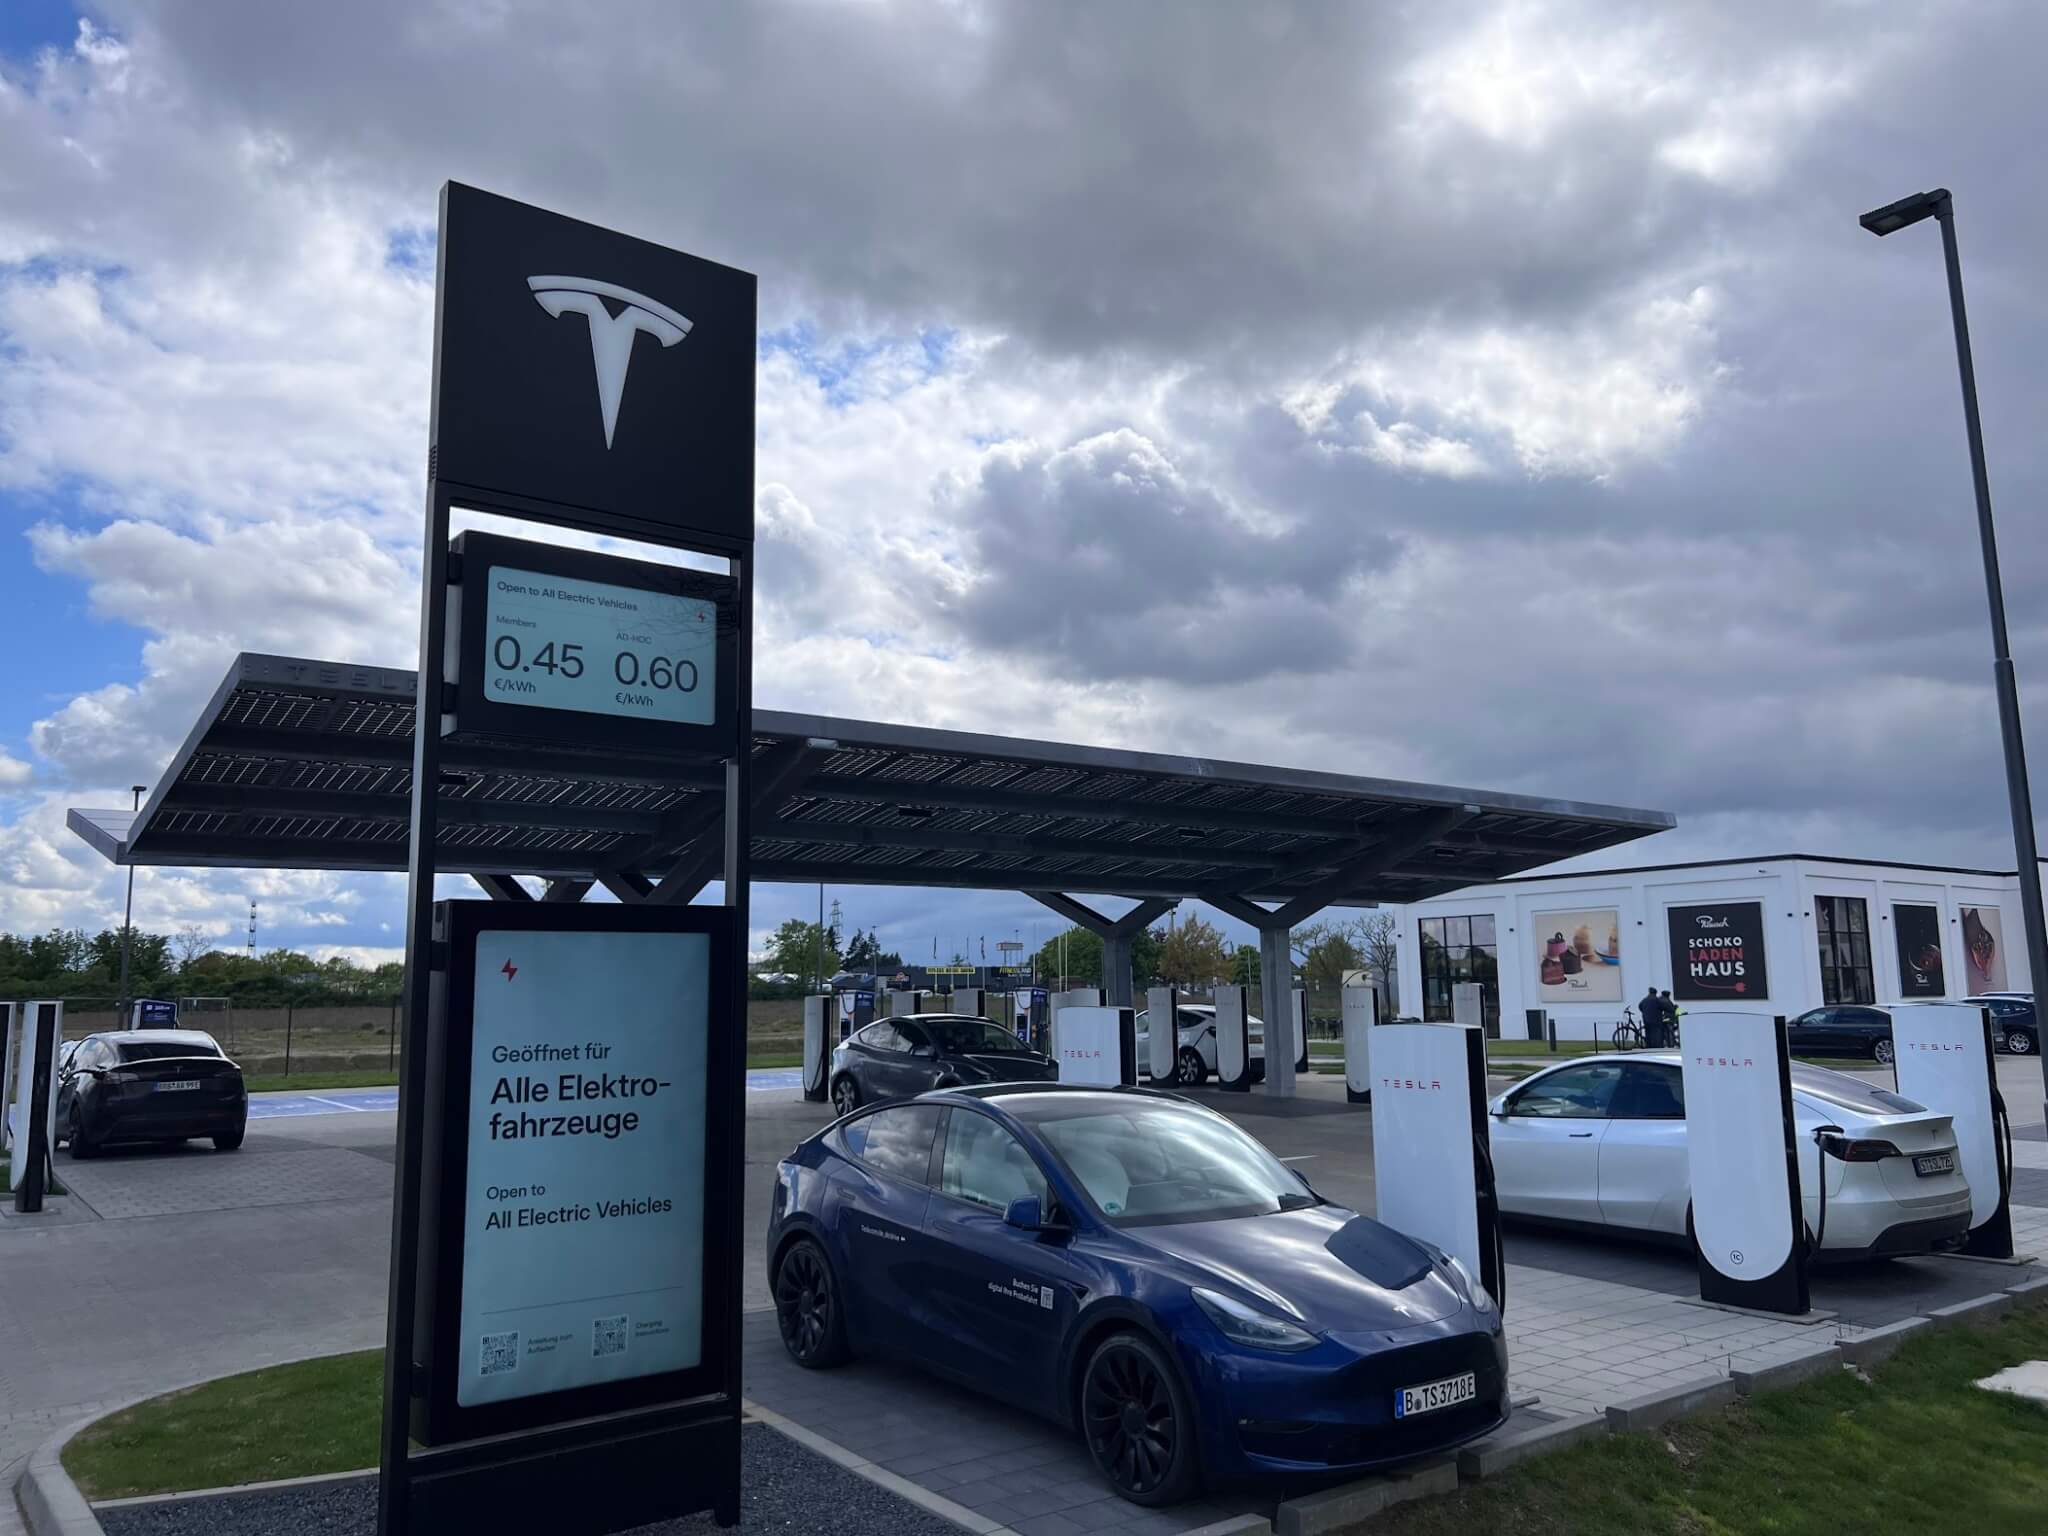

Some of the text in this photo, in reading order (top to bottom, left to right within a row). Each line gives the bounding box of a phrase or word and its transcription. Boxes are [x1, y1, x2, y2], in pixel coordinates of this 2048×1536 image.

[497, 581, 638, 611] Open to All Electric Vehicles
[496, 615, 537, 628] Members
[494, 635, 585, 679] 0.45
[615, 651, 698, 692] 0.60
[494, 677, 537, 694] €/kWh
[615, 692, 654, 707] €/kWh
[1688, 936, 1743, 948] SCHOKO
[1689, 948, 1744, 961] LADEN
[1690, 961, 1745, 977] HAUS
[491, 1042, 611, 1063] Geöffnet für
[1064, 1049, 1101, 1059] TESLA
[1909, 1043, 1963, 1051] TESLA
[1695, 1057, 1753, 1067] TESLA
[490, 1073, 671, 1105] Alle Elektro-
[1383, 1079, 1441, 1090] TESLA
[489, 1111, 639, 1140] fahrzeuge
[486, 1184, 546, 1202] Open to
[485, 1197, 672, 1230] All Electric Vehicles
[1405, 1391, 1413, 1412] B
